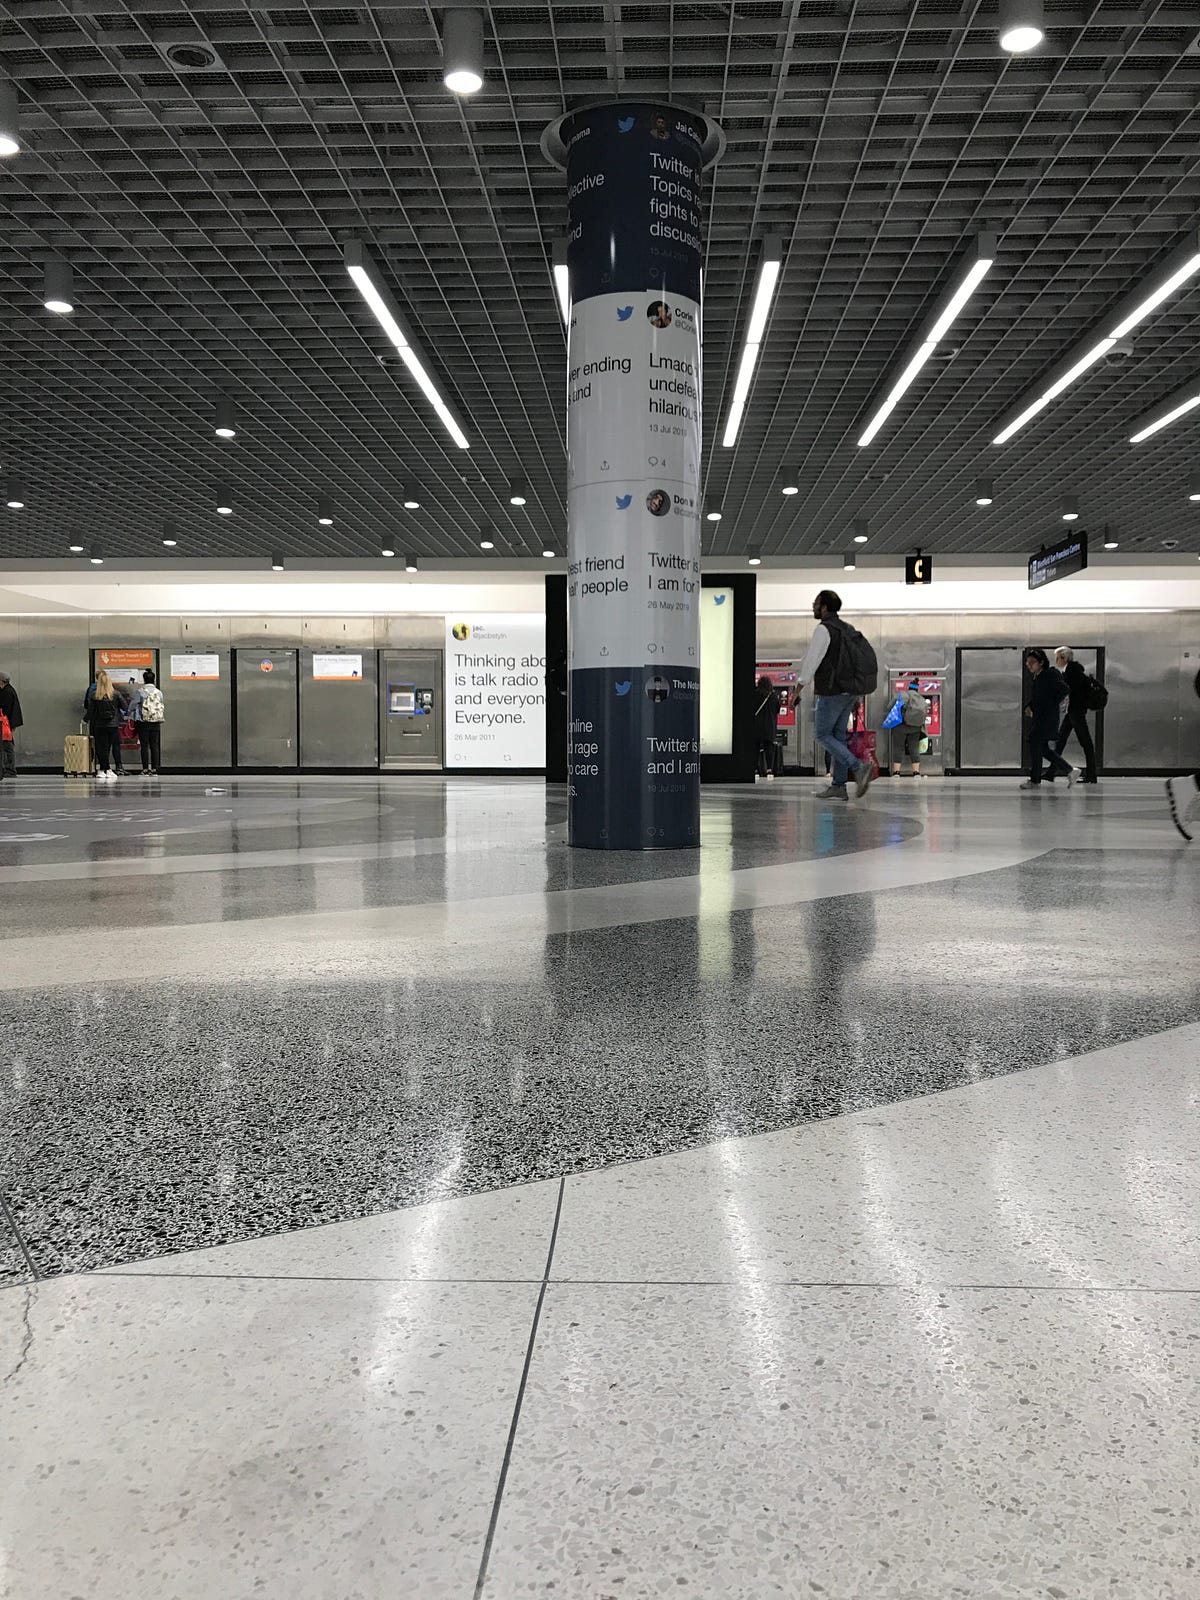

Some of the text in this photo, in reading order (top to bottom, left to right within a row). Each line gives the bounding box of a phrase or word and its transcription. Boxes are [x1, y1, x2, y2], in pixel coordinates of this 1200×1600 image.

[675, 122, 687, 133] Jai
[649, 152, 693, 180] Twitter
[649, 175, 693, 202] Topics
[649, 198, 698, 228] fights to
[583, 355, 632, 374] ending
[573, 382, 592, 403] and
[649, 424, 659, 433] 13
[660, 425, 672, 435] Jul
[585, 554, 625, 572] friend
[648, 552, 691, 570] Twitter
[581, 577, 629, 598] people
[648, 574, 652, 590] I
[657, 578, 679, 591] am
[682, 577, 696, 593] for
[648, 600, 658, 609] 26
[660, 601, 674, 611] May
[454, 653, 516, 671] Thinking
[455, 672, 467, 686] is
[471, 672, 498, 686] talk
[502, 672, 539, 686] radio
[672, 679, 686, 689] The
[454, 691, 546, 709] and everyon
[455, 710, 526, 727] Everyone.
[574, 742, 599, 758] rage
[646, 737, 698, 753] Twitter is
[574, 764, 599, 776] care
[647, 759, 675, 774] and
[685, 762, 698, 774] am
